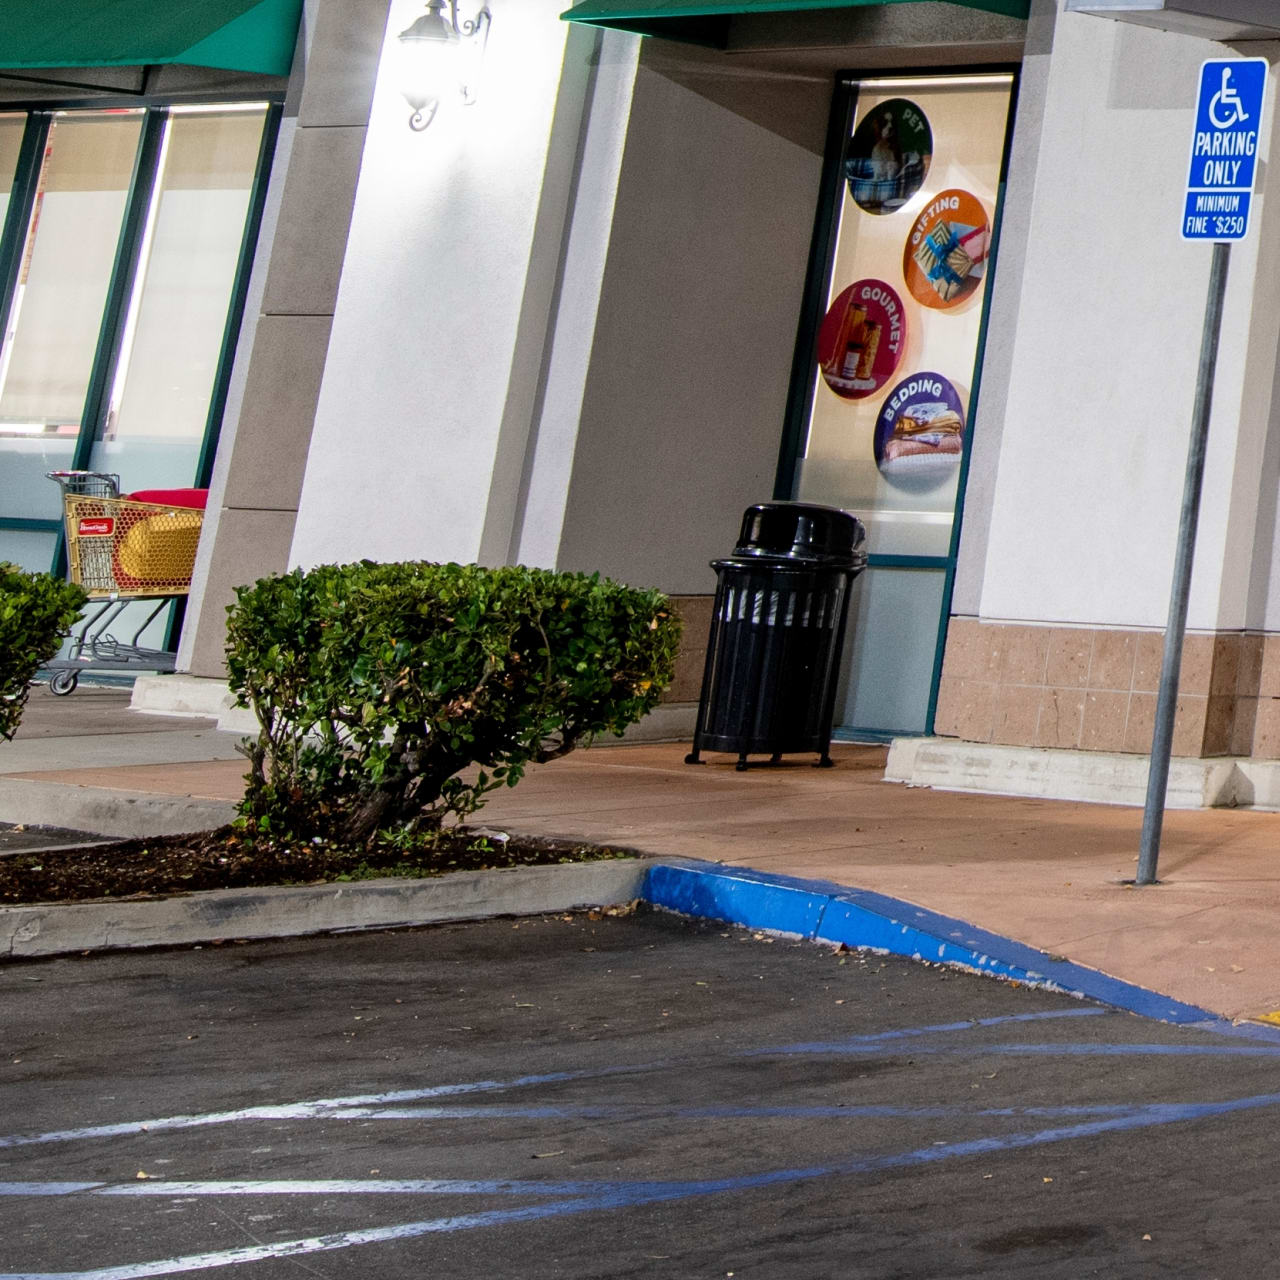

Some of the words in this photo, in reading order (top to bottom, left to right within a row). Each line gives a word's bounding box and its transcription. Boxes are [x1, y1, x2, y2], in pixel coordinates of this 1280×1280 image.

[902, 108, 925, 133] PET
[1195, 131, 1256, 156] PARKING
[1203, 160, 1241, 185] ONLY
[1196, 196, 1240, 212] MINIMUM
[912, 196, 959, 245] GIFTING
[1186, 216, 1208, 233] FINE
[1215, 216, 1244, 235] $250
[861, 286, 900, 354] GOURMET
[884, 379, 942, 421] BEDDING
